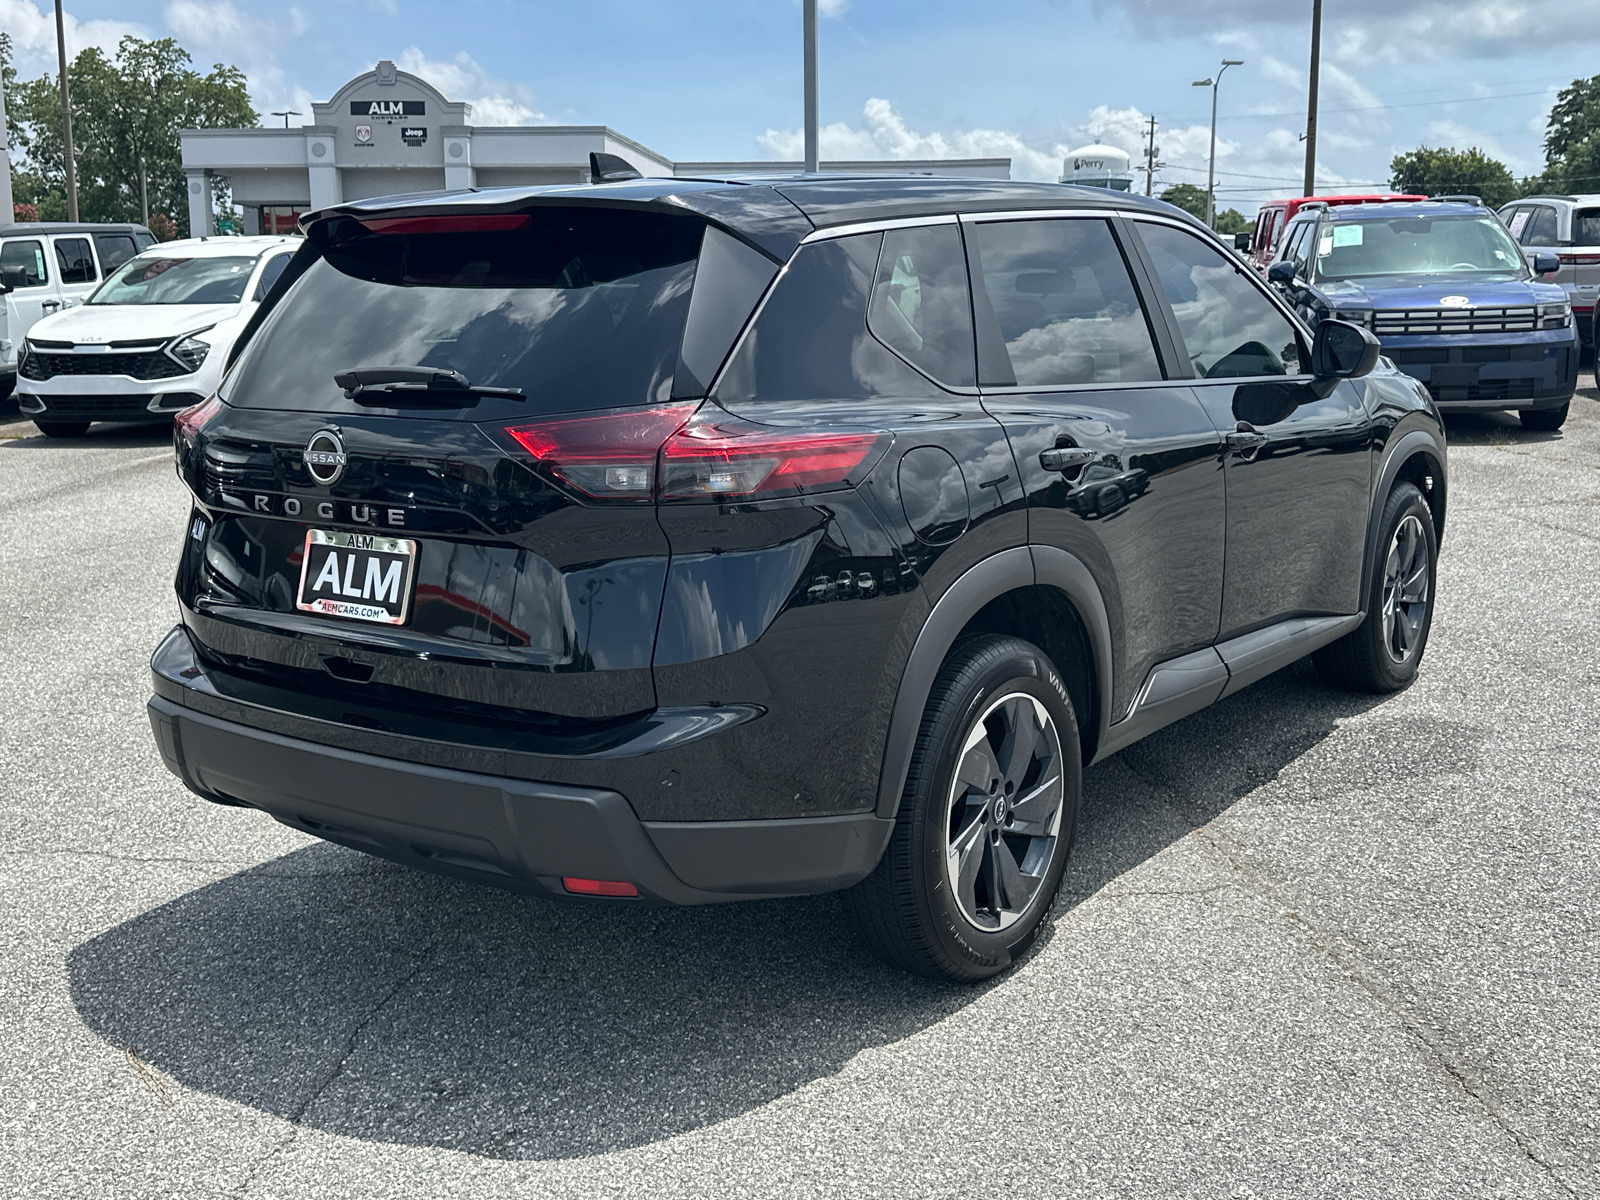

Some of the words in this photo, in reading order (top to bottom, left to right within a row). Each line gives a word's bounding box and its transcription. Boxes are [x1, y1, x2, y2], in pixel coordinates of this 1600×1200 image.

[368, 101, 403, 115] ALM
[405, 128, 423, 137] Jeep
[1081, 159, 1104, 169] Perry
[304, 453, 345, 465] NISSAN
[254, 494, 405, 526] ROGUE
[347, 534, 374, 549] ALM
[312, 551, 403, 604] ALM
[321, 602, 380, 618] ALMCARS.COM
